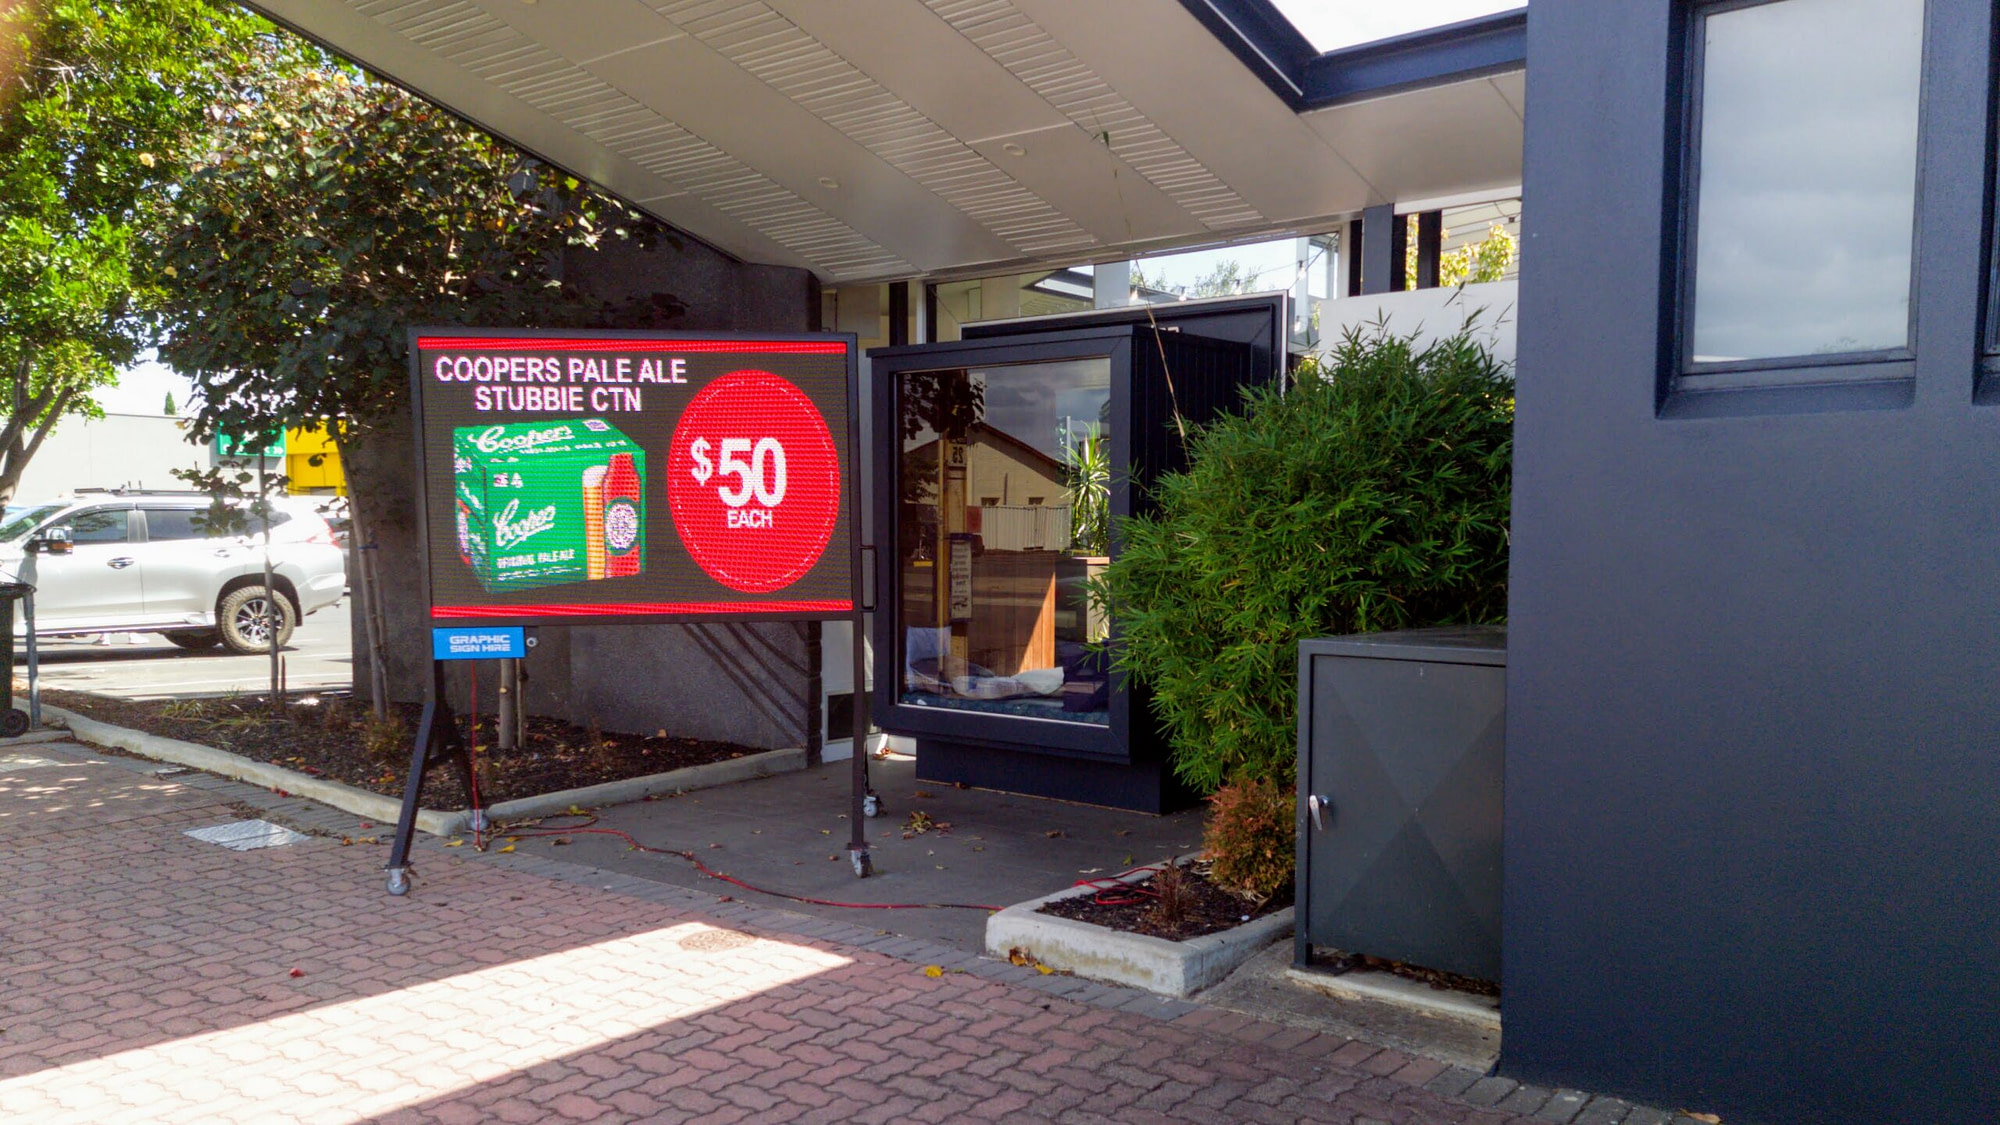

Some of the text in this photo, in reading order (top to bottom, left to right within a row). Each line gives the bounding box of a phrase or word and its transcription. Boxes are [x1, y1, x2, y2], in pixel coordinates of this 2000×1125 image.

[435, 356, 687, 384] COOPERS PALE ALE
[475, 386, 642, 411] STUBBIE CTN
[727, 510, 773, 528] EACH
[449, 634, 511, 644] GRAPHIC
[449, 643, 511, 653] SIGN HIRE
